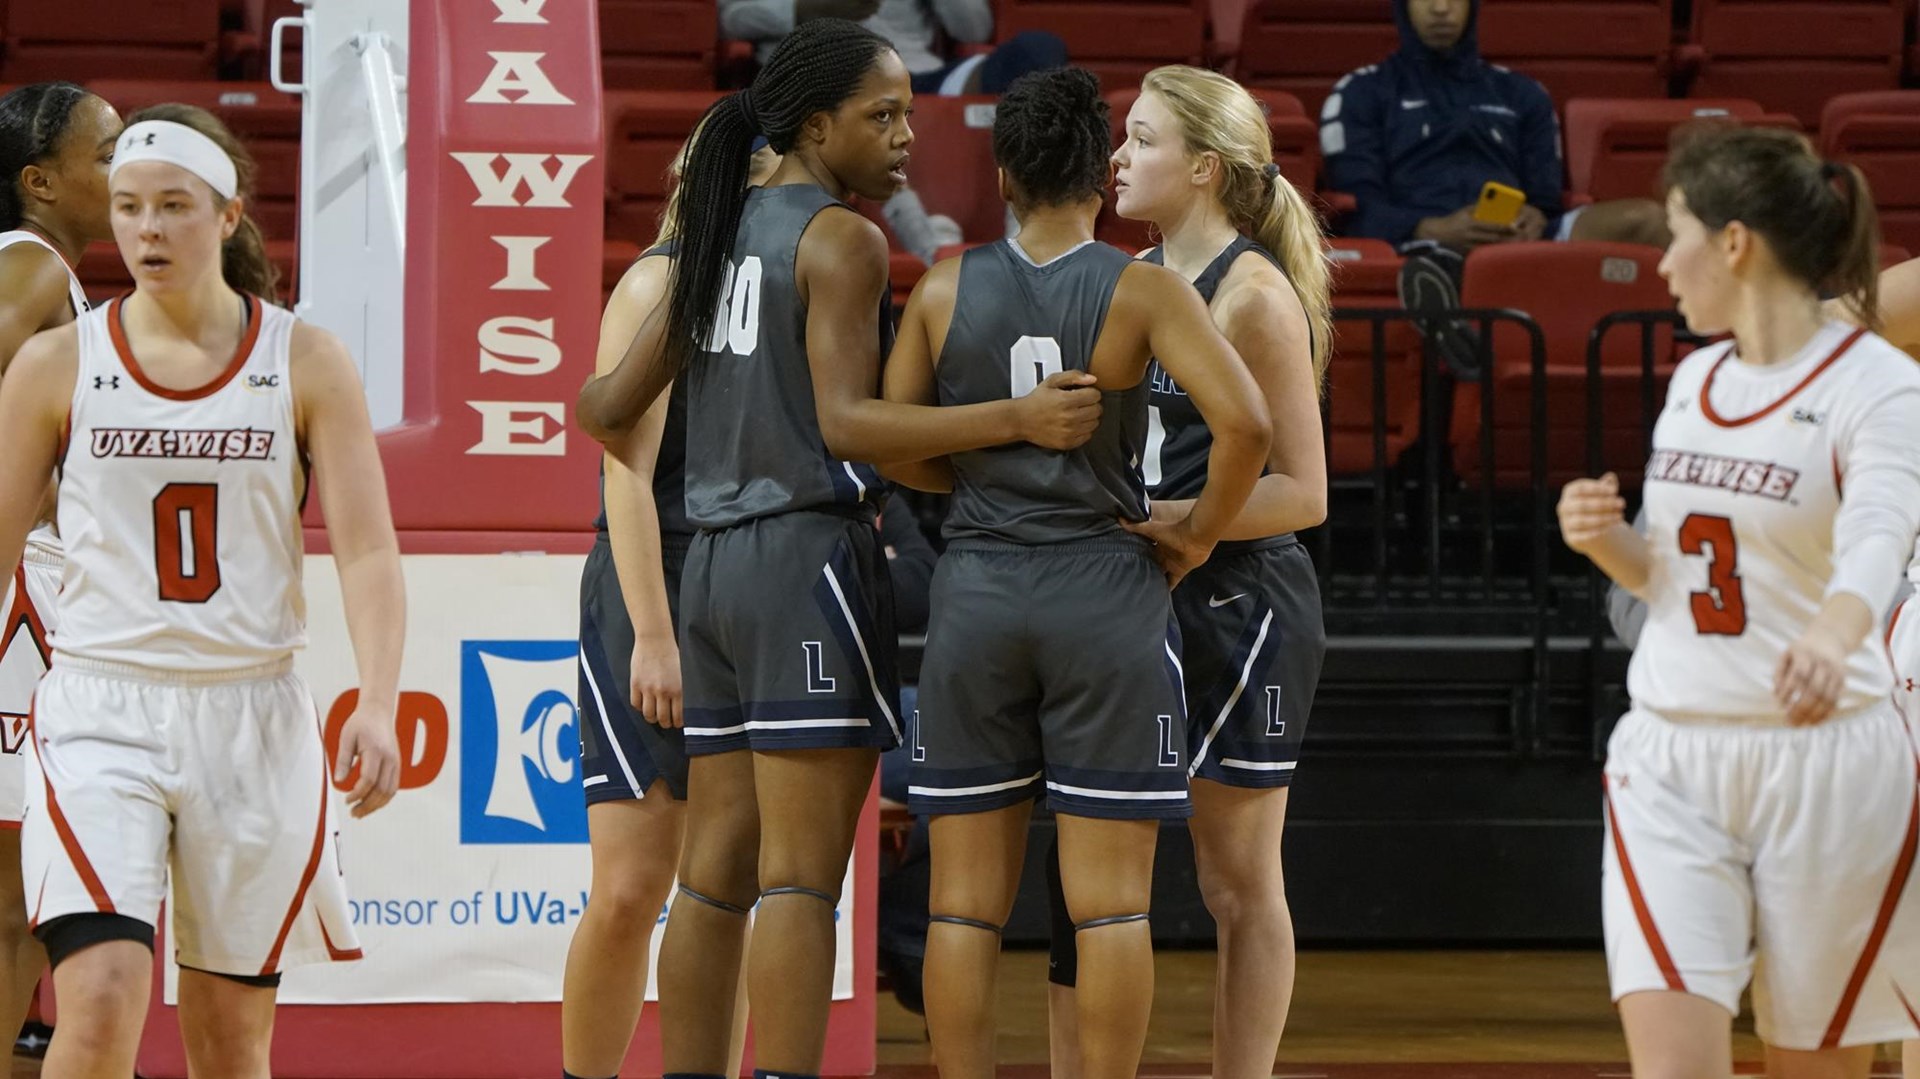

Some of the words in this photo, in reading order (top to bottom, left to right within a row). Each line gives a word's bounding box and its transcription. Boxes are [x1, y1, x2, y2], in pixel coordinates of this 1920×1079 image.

[248, 374, 279, 387] SAC
[91, 427, 274, 463] UVA-WISE
[153, 482, 221, 603] 0
[1679, 513, 1746, 636] 3
[802, 641, 836, 692] L
[1266, 686, 1286, 736] L
[1157, 715, 1179, 766] L
[451, 892, 482, 925] of
[495, 891, 592, 925] UVa-
